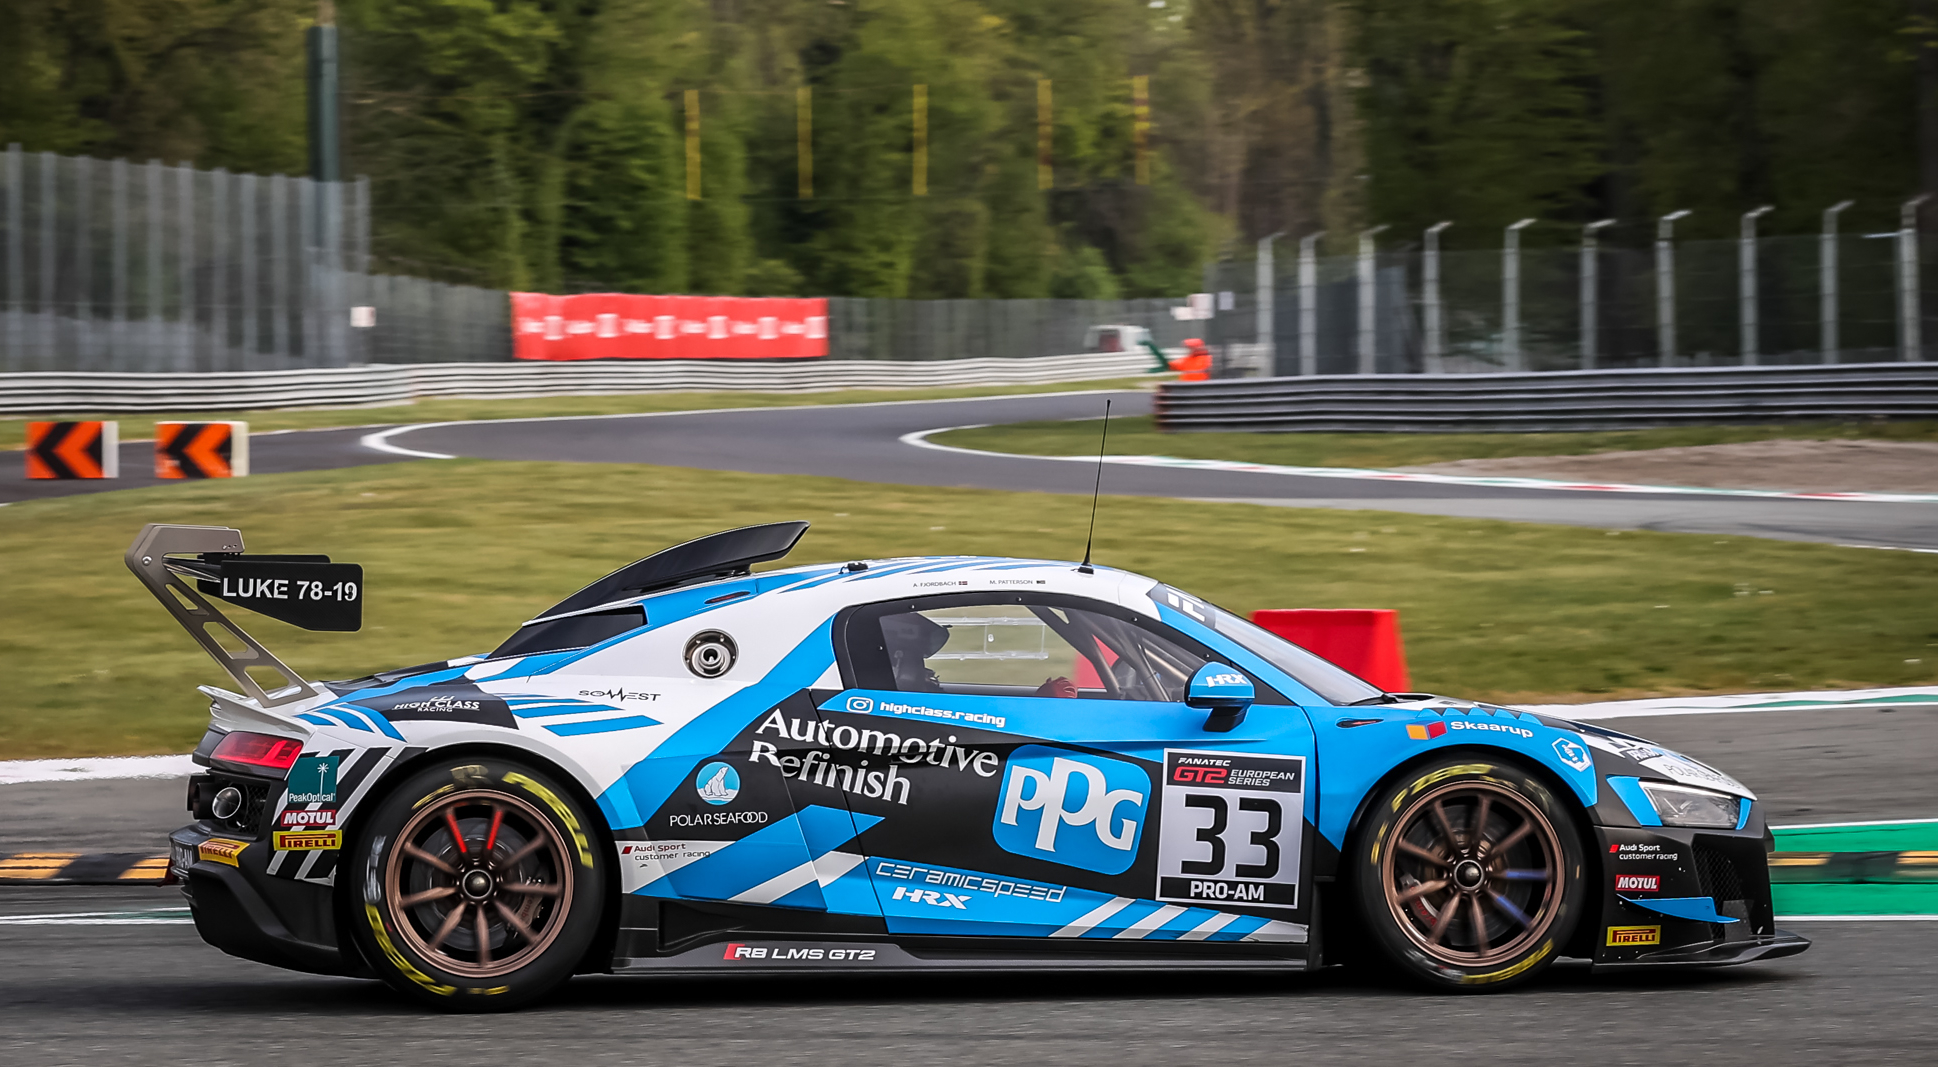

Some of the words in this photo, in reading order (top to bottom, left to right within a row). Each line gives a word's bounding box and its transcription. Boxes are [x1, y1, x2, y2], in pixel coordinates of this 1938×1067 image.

[223, 578, 289, 599] LUKE
[297, 580, 358, 601] 78-19
[1206, 674, 1247, 687] HRX
[394, 701, 431, 709] HIGH
[434, 700, 480, 709] CLASS
[880, 702, 1006, 728] highclass.racing
[1450, 721, 1534, 738] Skaarup
[755, 708, 999, 778] Automotive
[1178, 758, 1231, 766] FANATEC
[748, 740, 911, 805] Refinish
[1173, 766, 1228, 784] GT2
[1231, 769, 1295, 780] EUROPEAN
[1228, 776, 1270, 786] SERIES
[1000, 757, 1144, 852] PPG
[283, 812, 334, 824] MOTUL
[280, 833, 336, 848] PIRELLI
[1180, 793, 1283, 879] 33
[634, 845, 655, 853] Audi
[658, 843, 686, 853] Sport
[1639, 844, 1660, 852] Sport
[635, 852, 679, 861] customer
[683, 850, 711, 858] racing
[1656, 853, 1678, 861] racing
[1617, 877, 1657, 889] MOTUL
[892, 886, 973, 910] HRX
[1190, 881, 1265, 901] PRO-AM
[1612, 929, 1656, 943] PIRELLI
[734, 946, 768, 959] R8
[772, 948, 823, 960] LMS
[828, 949, 875, 960] GT2
